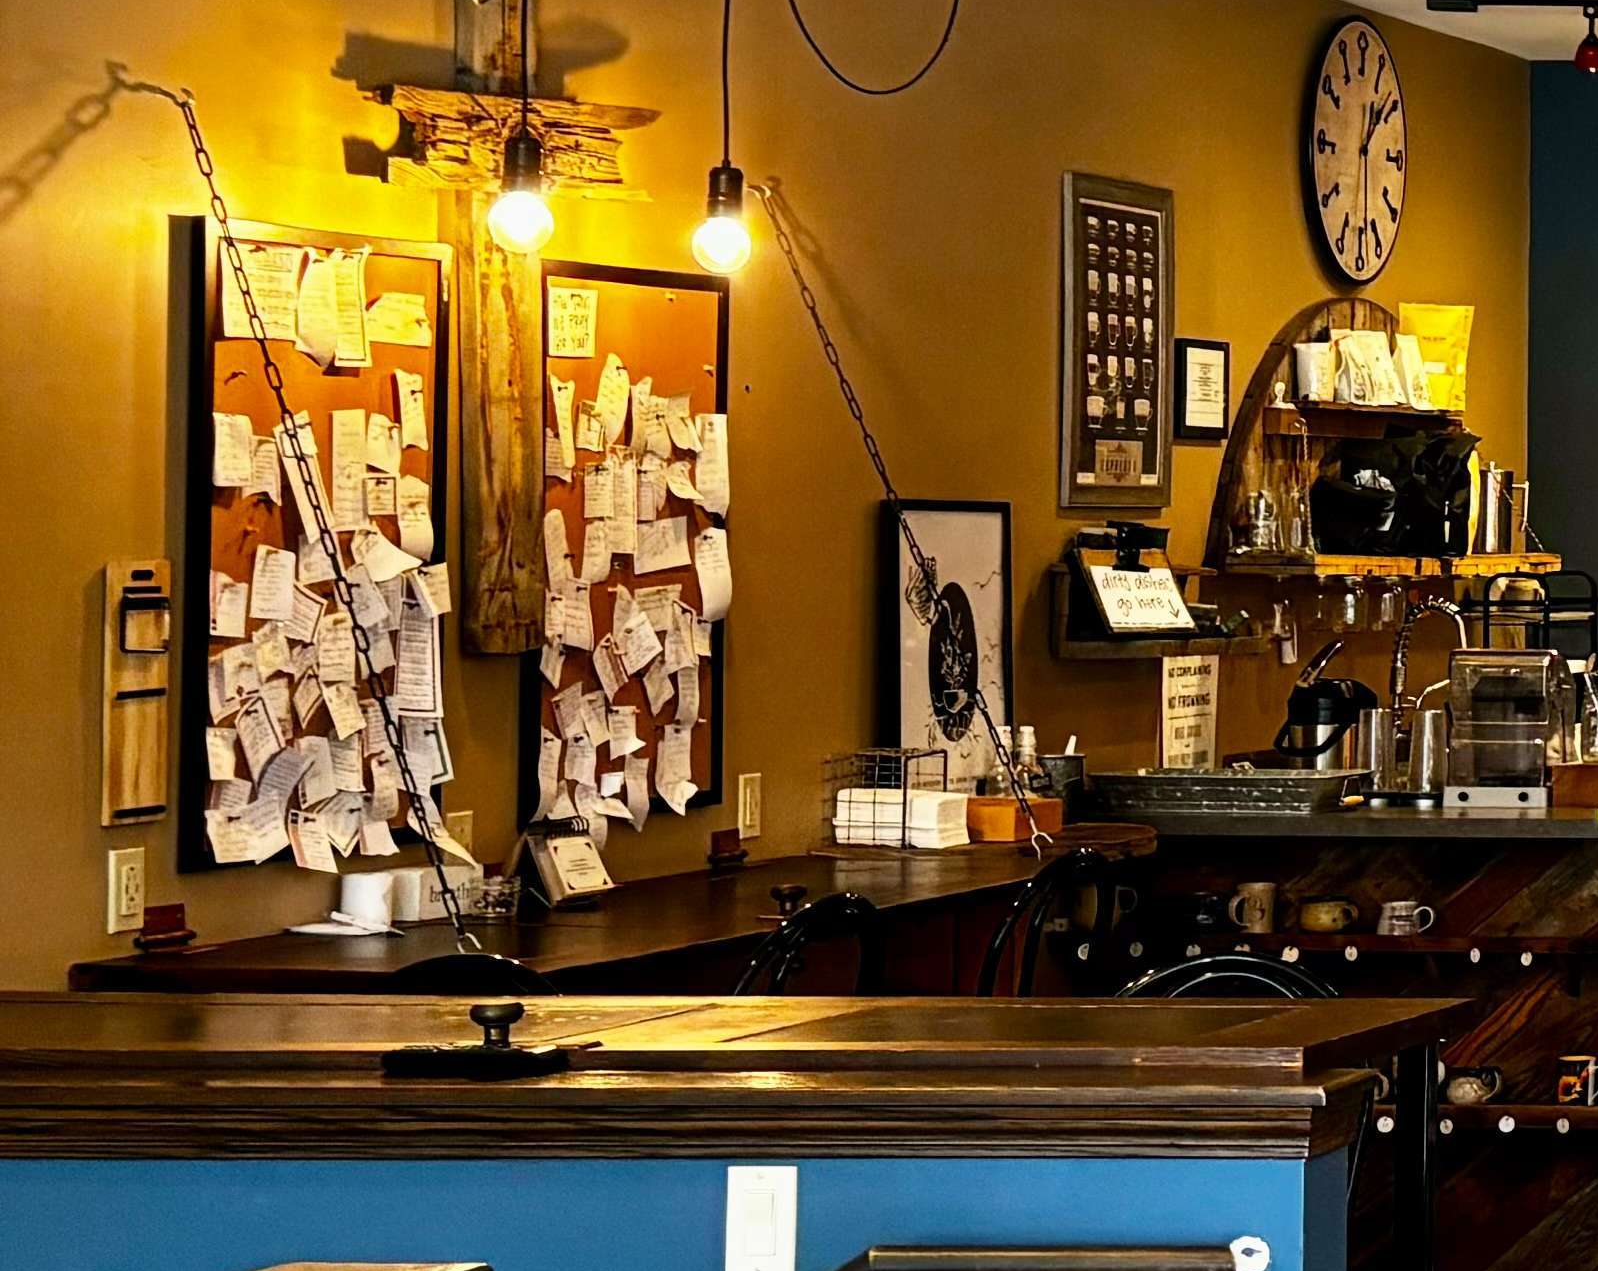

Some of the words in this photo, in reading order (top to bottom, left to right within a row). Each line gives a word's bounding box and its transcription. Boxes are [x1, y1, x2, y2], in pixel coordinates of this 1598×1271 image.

[1101, 572, 1131, 592] dirty
[1116, 596, 1133, 618] go
[1136, 596, 1165, 611] here
[1176, 664, 1213, 678] COMPLAINING
[1177, 692, 1211, 709] FROWNING
